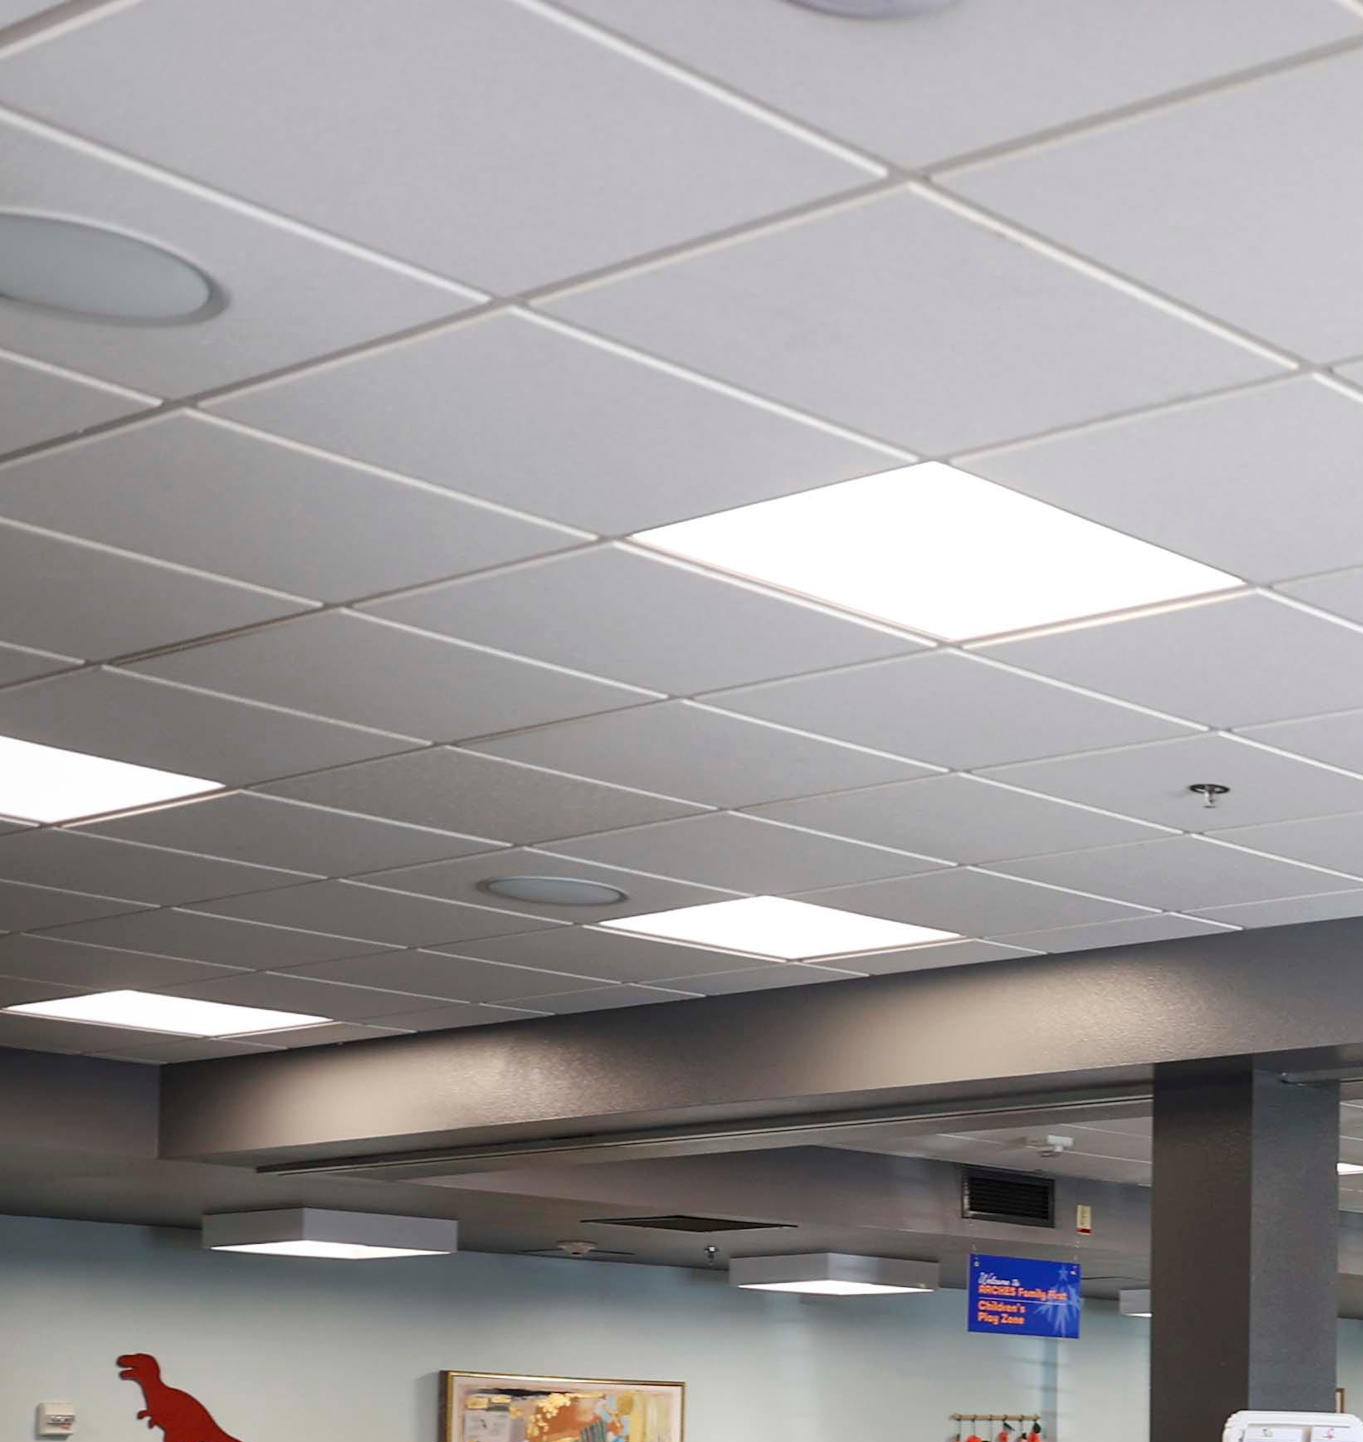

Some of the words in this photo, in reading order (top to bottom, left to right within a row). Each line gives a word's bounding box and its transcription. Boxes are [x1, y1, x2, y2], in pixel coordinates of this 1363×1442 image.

[979, 1271, 1011, 1286] Welcome
[978, 1284, 1017, 1297] ARCHES
[1018, 1287, 1047, 1301] Family
[1047, 1289, 1068, 1301] First
[978, 1300, 1026, 1313] Children's
[978, 1311, 1000, 1325] Play
[1001, 1313, 1025, 1324] Zone
